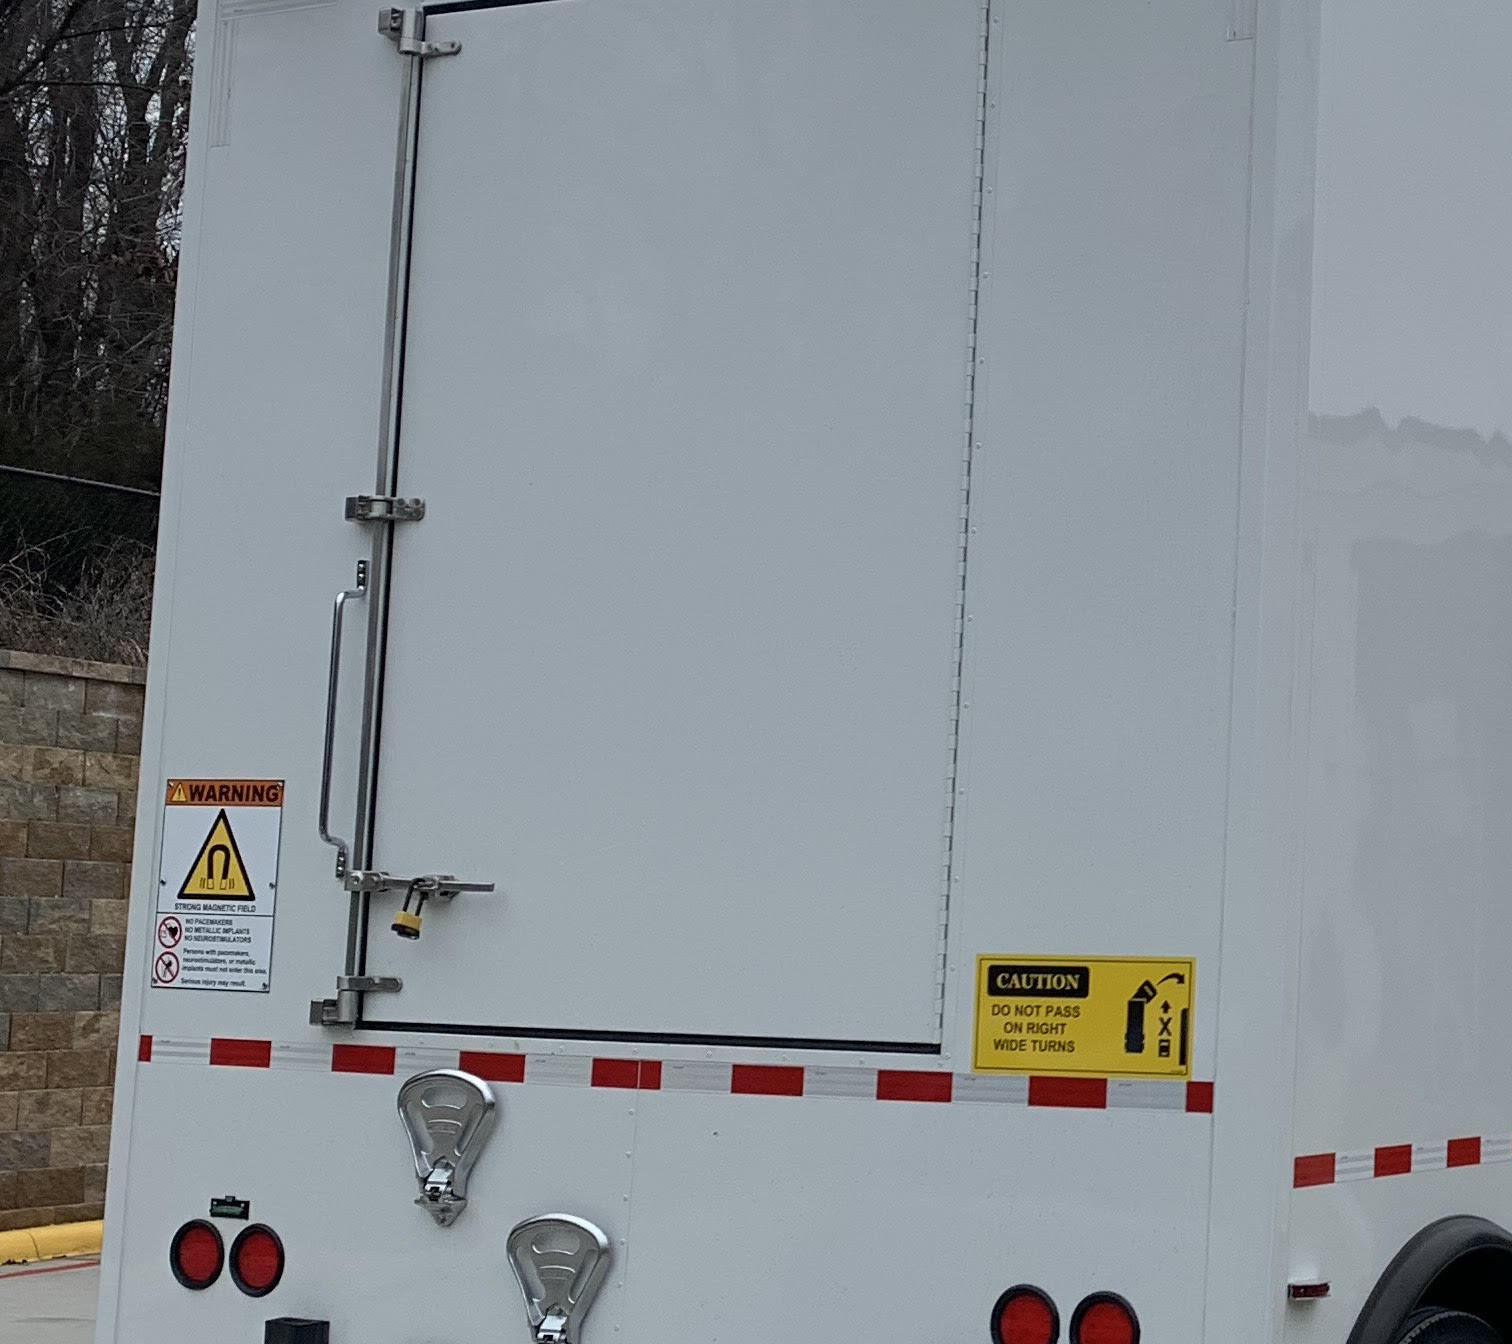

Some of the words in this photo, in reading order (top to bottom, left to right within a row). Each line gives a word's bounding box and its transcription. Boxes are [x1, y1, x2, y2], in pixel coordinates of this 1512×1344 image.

[189, 784, 279, 803] WARNING
[174, 902, 201, 911] STRONG
[202, 903, 236, 912] MAGNETIC
[237, 904, 257, 913] FIELD
[194, 918, 233, 926] PACEMAKERS
[222, 927, 250, 935] IMPLANTS
[193, 935, 251, 943] NEUROSTIMULATORS
[183, 947, 204, 955] Persons
[181, 965, 204, 973] implants
[181, 977, 201, 985] Serious
[202, 978, 216, 987] injury
[996, 972, 1080, 990] CAUTION
[992, 1004, 1011, 1016] DO
[1014, 1004, 1042, 1017] NOT
[1045, 1005, 1081, 1018] PASS
[1003, 1021, 1023, 1034] ON
[1026, 1022, 1067, 1035] RIGHT
[992, 1038, 1027, 1051] WIDE
[1030, 1039, 1076, 1053] TURNS
